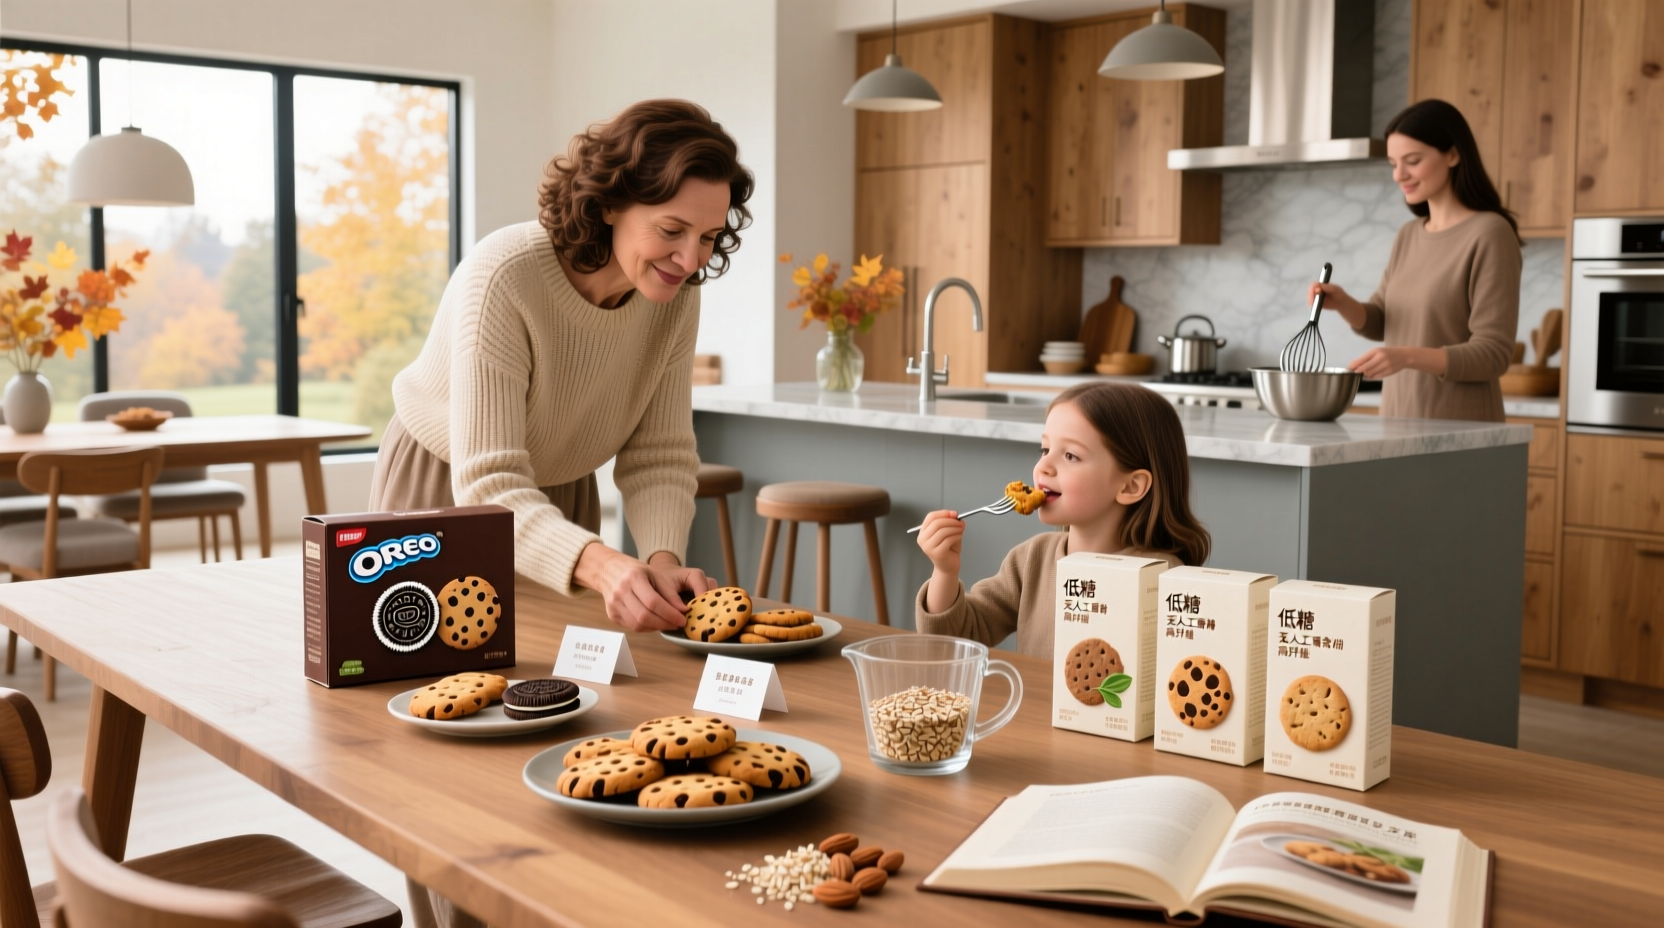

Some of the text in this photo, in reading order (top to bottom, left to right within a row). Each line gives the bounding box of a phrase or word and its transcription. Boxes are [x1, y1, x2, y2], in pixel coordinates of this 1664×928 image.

[353, 537, 437, 577] OREO
[1063, 578, 1096, 598] 低糖
[1166, 592, 1201, 614] 低糖
[1278, 608, 1315, 631] 低糖
